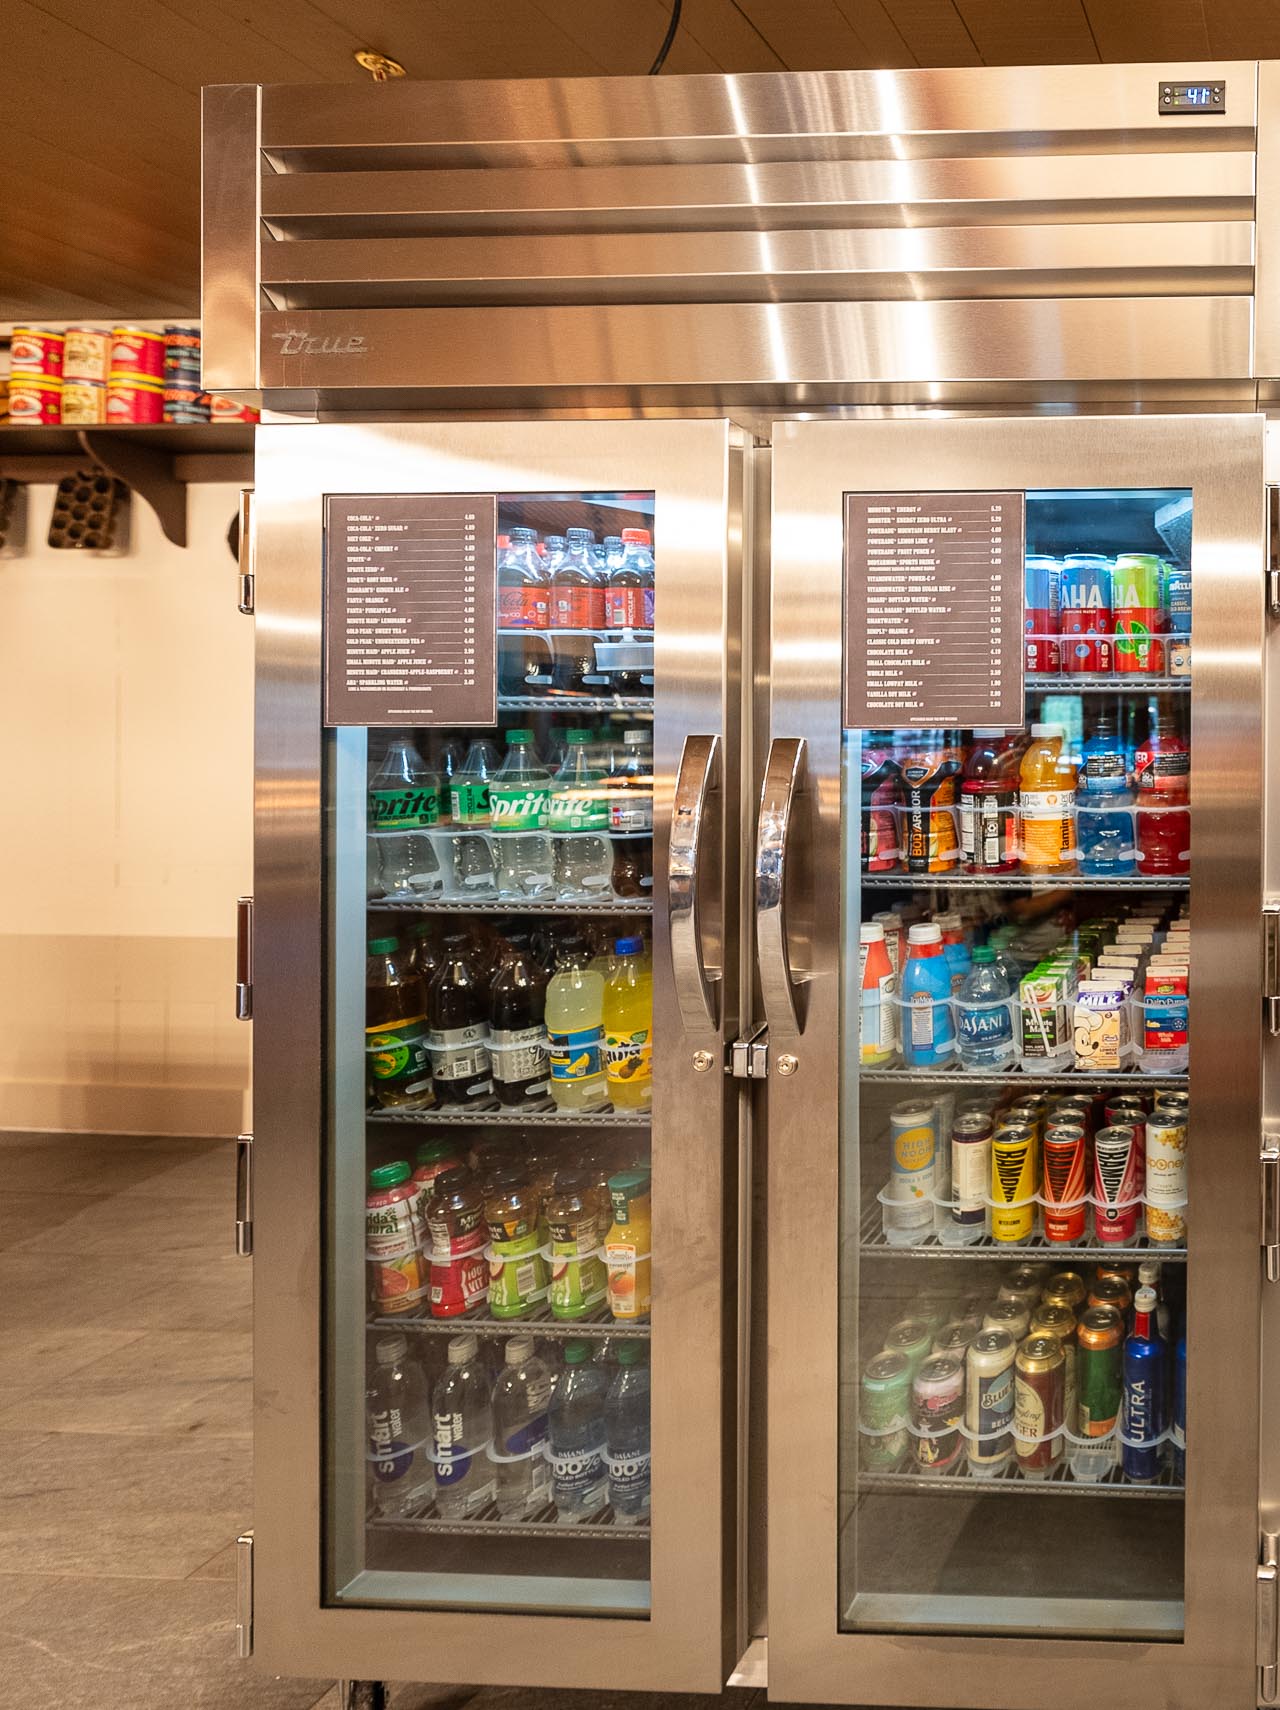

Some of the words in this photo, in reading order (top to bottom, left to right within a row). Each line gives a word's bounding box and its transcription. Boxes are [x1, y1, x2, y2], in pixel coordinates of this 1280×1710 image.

[272, 330, 368, 354] True
[1061, 585, 1104, 609] AHA
[1131, 1380, 1146, 1443] ULTRA
